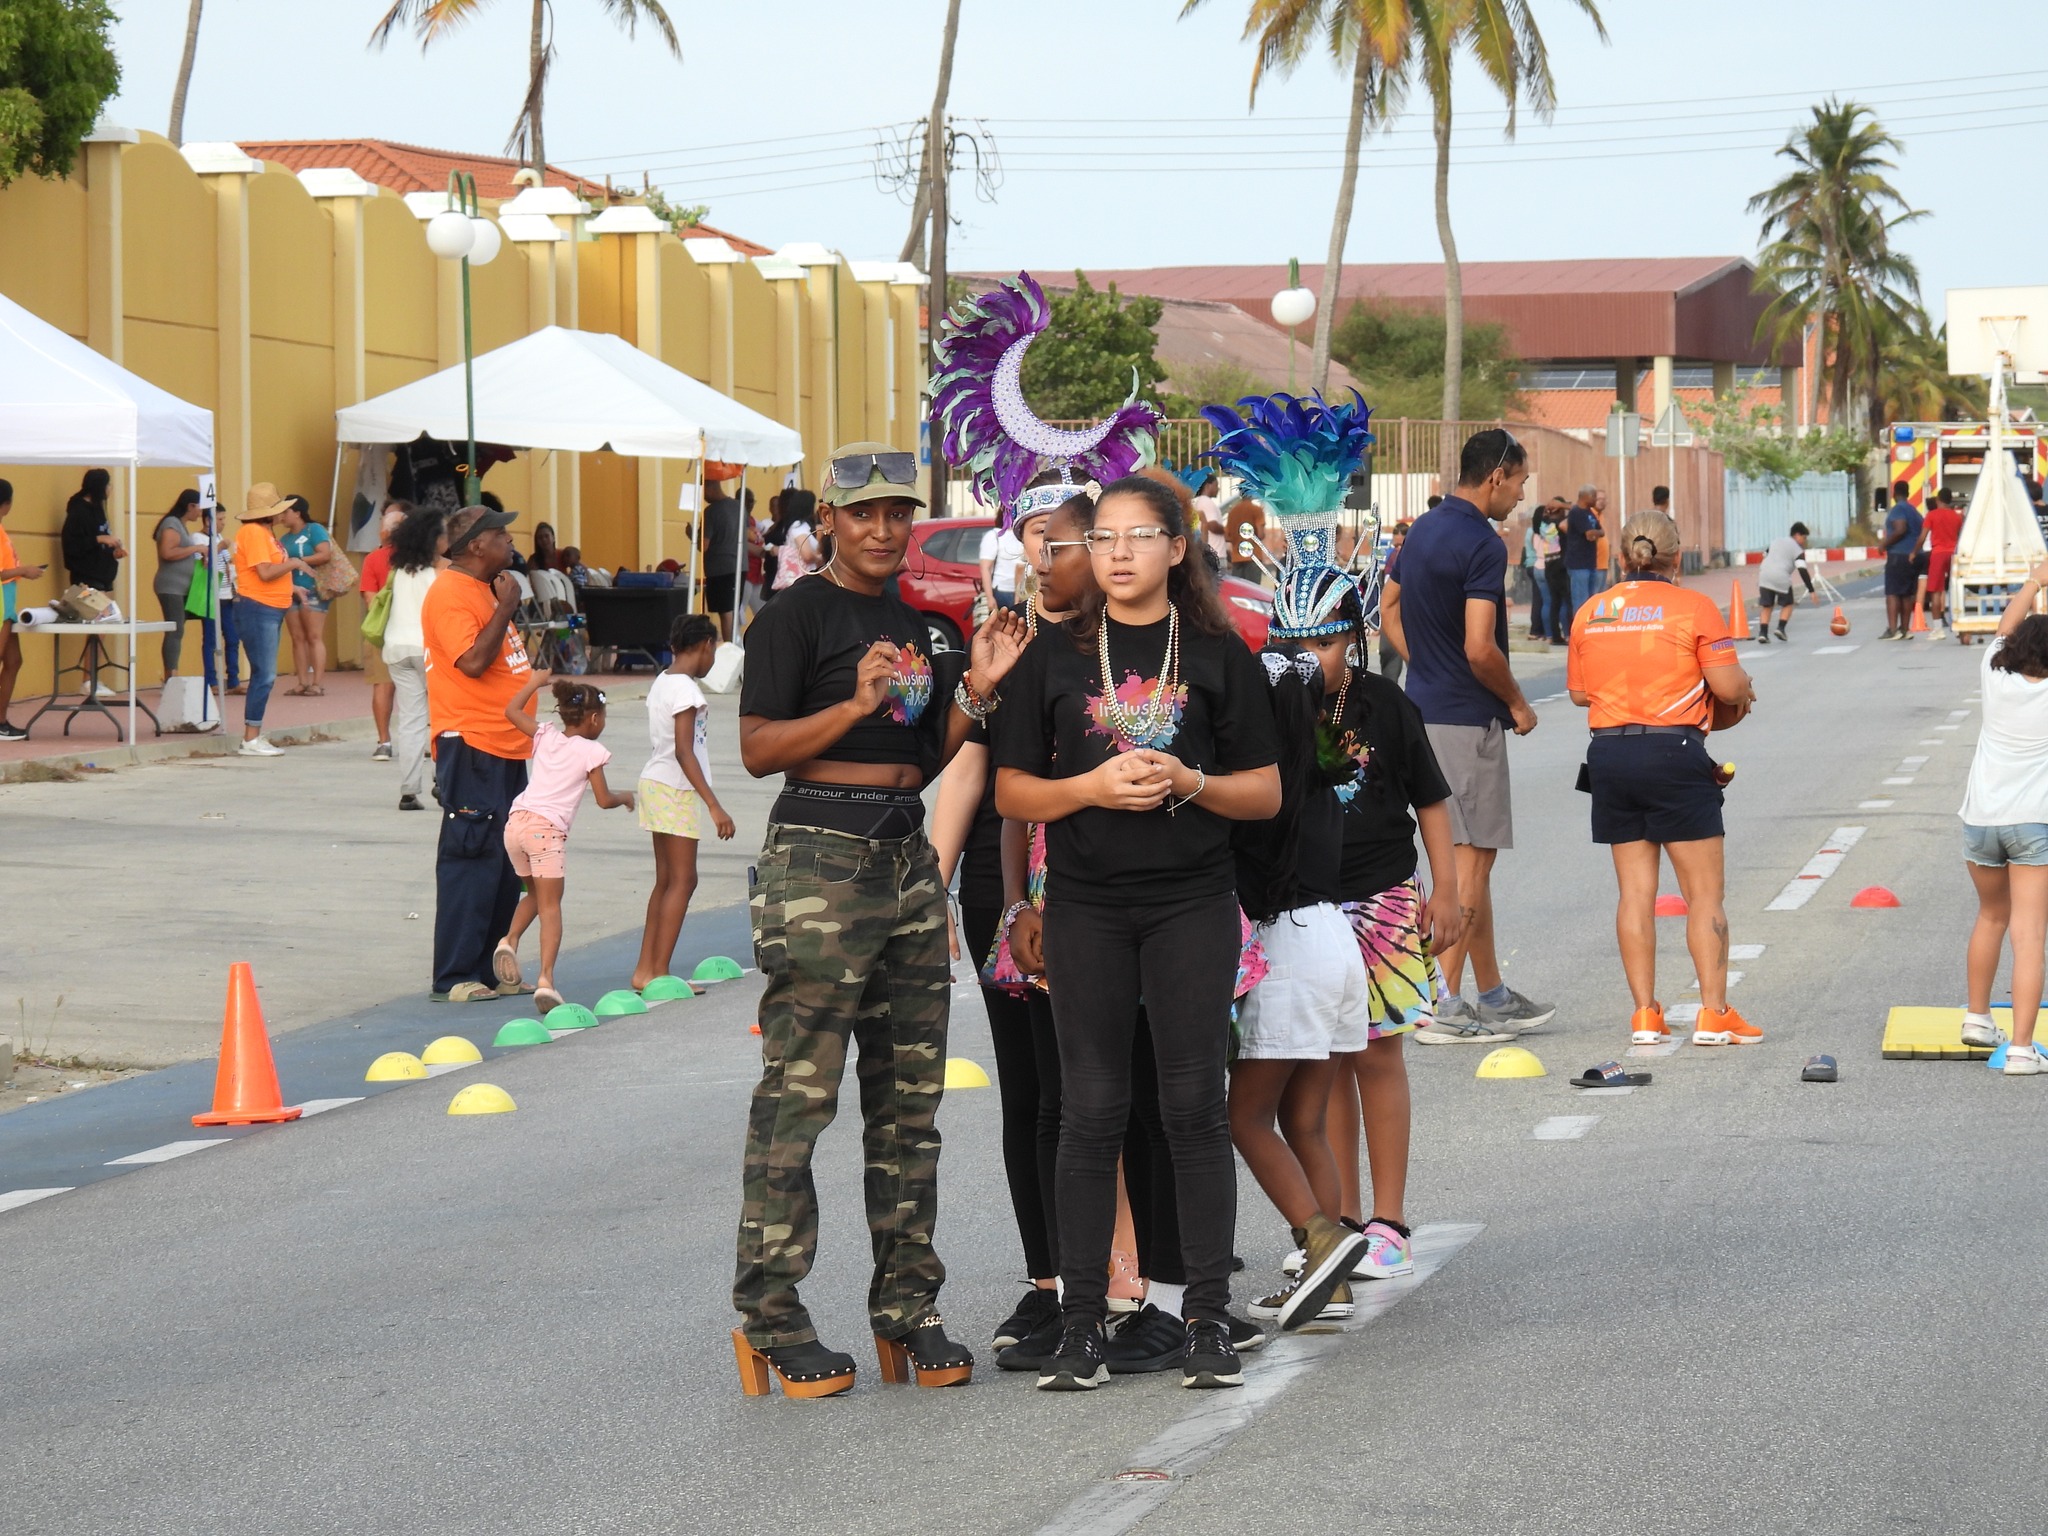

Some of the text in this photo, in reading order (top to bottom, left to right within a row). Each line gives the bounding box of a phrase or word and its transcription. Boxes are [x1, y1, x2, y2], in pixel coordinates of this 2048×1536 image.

[206, 482, 215, 501] 4
[1099, 701, 1175, 717] Inluson
[797, 787, 845, 798] armour
[851, 791, 889, 801] under
